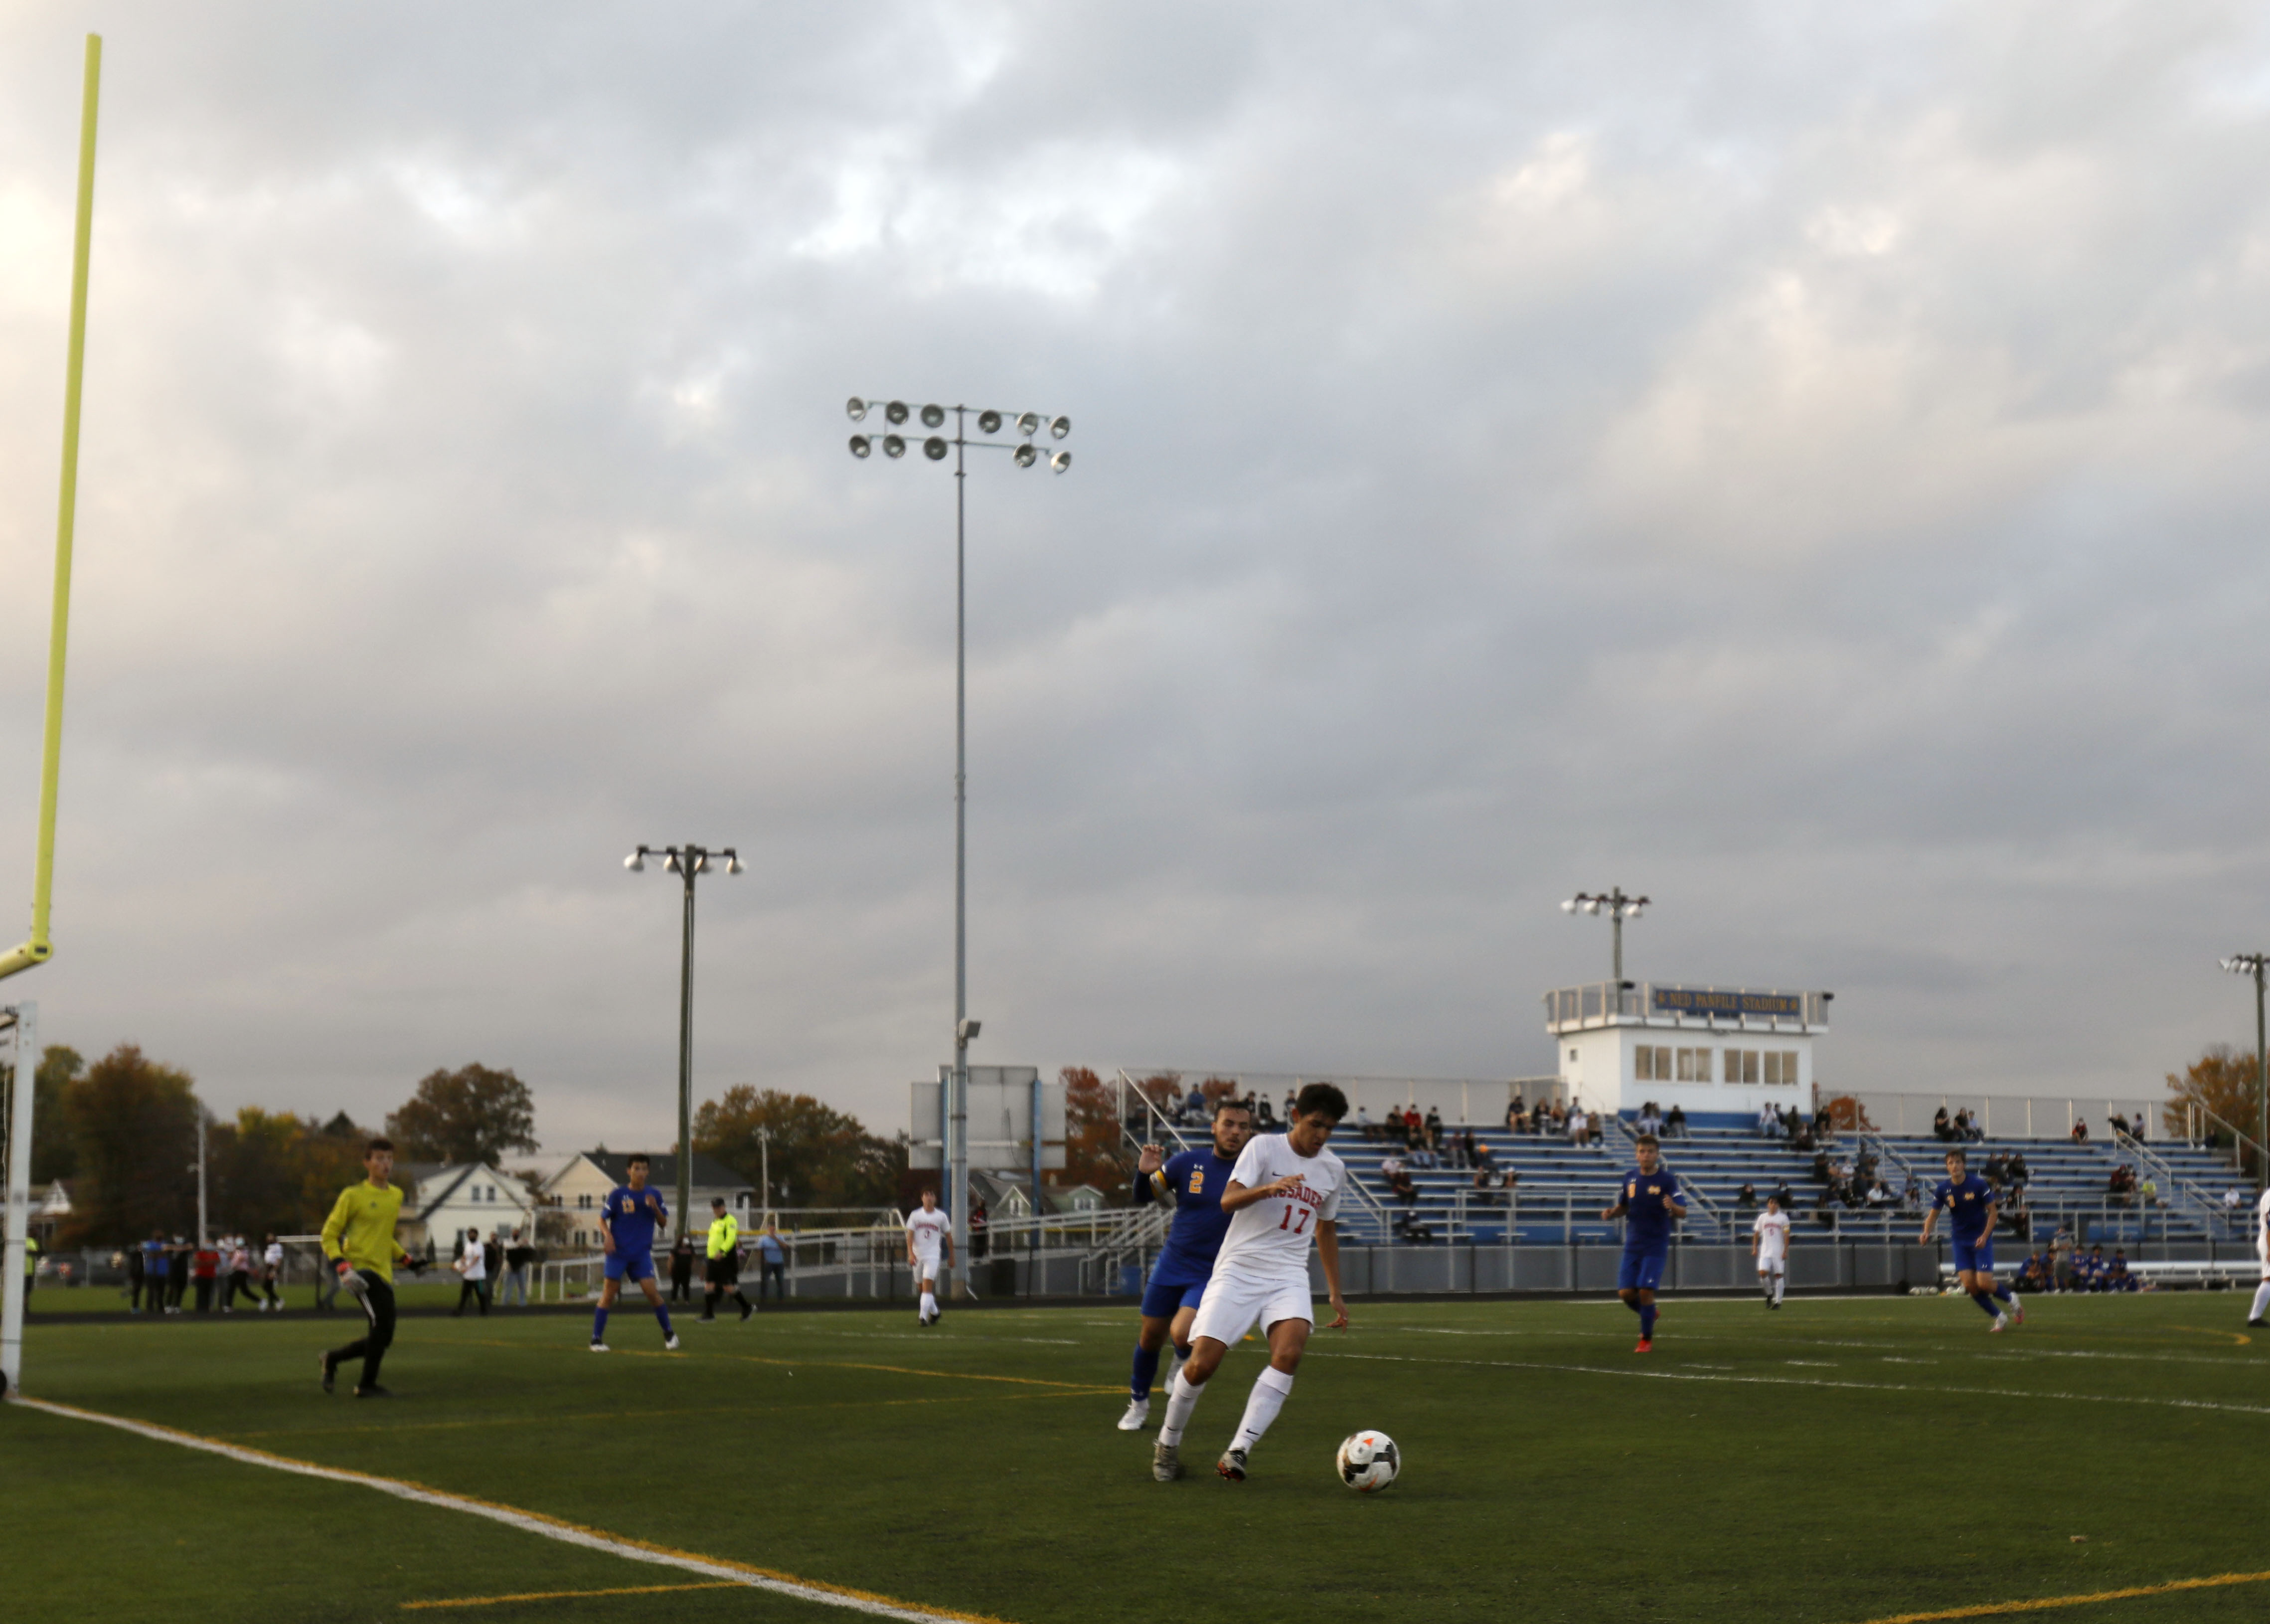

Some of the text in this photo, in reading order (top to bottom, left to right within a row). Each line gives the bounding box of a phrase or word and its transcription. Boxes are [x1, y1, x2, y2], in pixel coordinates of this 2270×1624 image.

[1670, 992, 1691, 1007] NED
[1742, 996, 1787, 1012] STADIUM
[1189, 1171, 1203, 1193] 2
[1279, 1204, 1309, 1234] 17
